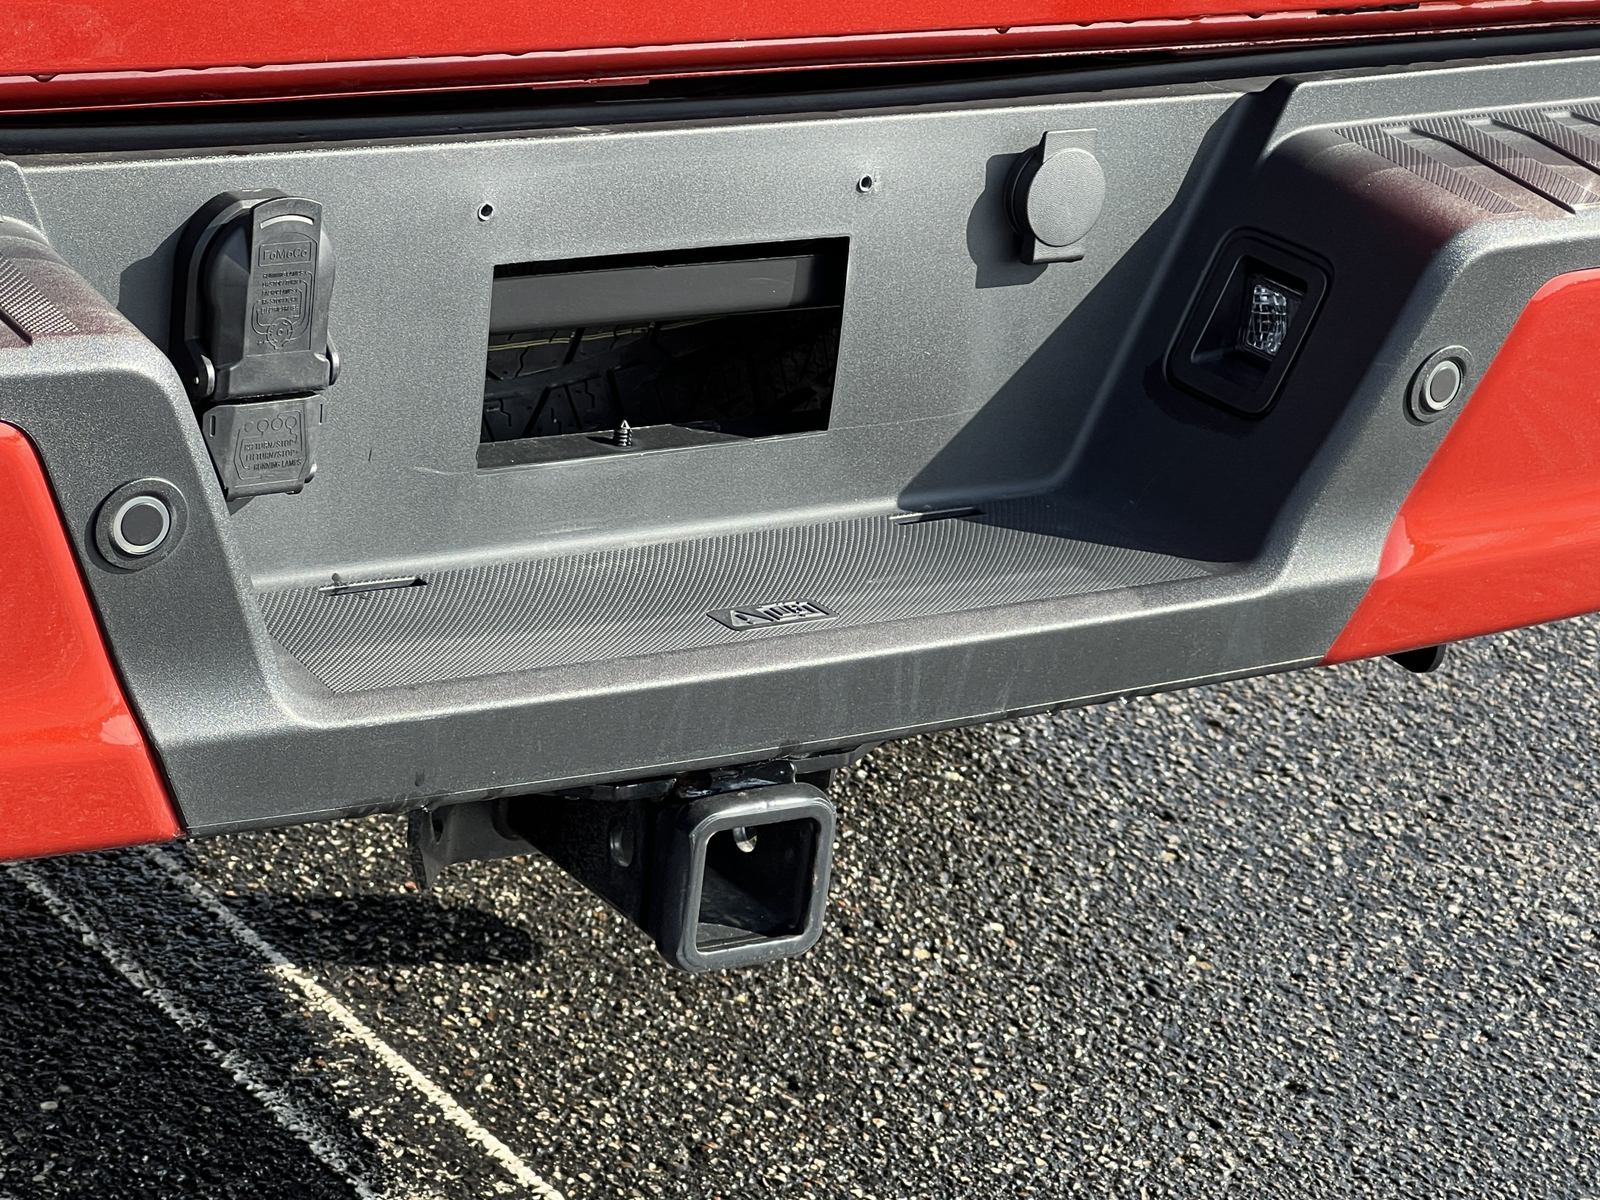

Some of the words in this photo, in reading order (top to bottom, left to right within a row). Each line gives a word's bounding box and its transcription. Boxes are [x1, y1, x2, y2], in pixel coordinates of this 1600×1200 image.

[263, 248, 307, 260] FoMoCo
[253, 461, 280, 470] RUNNING
[281, 458, 302, 467] LAMPS
